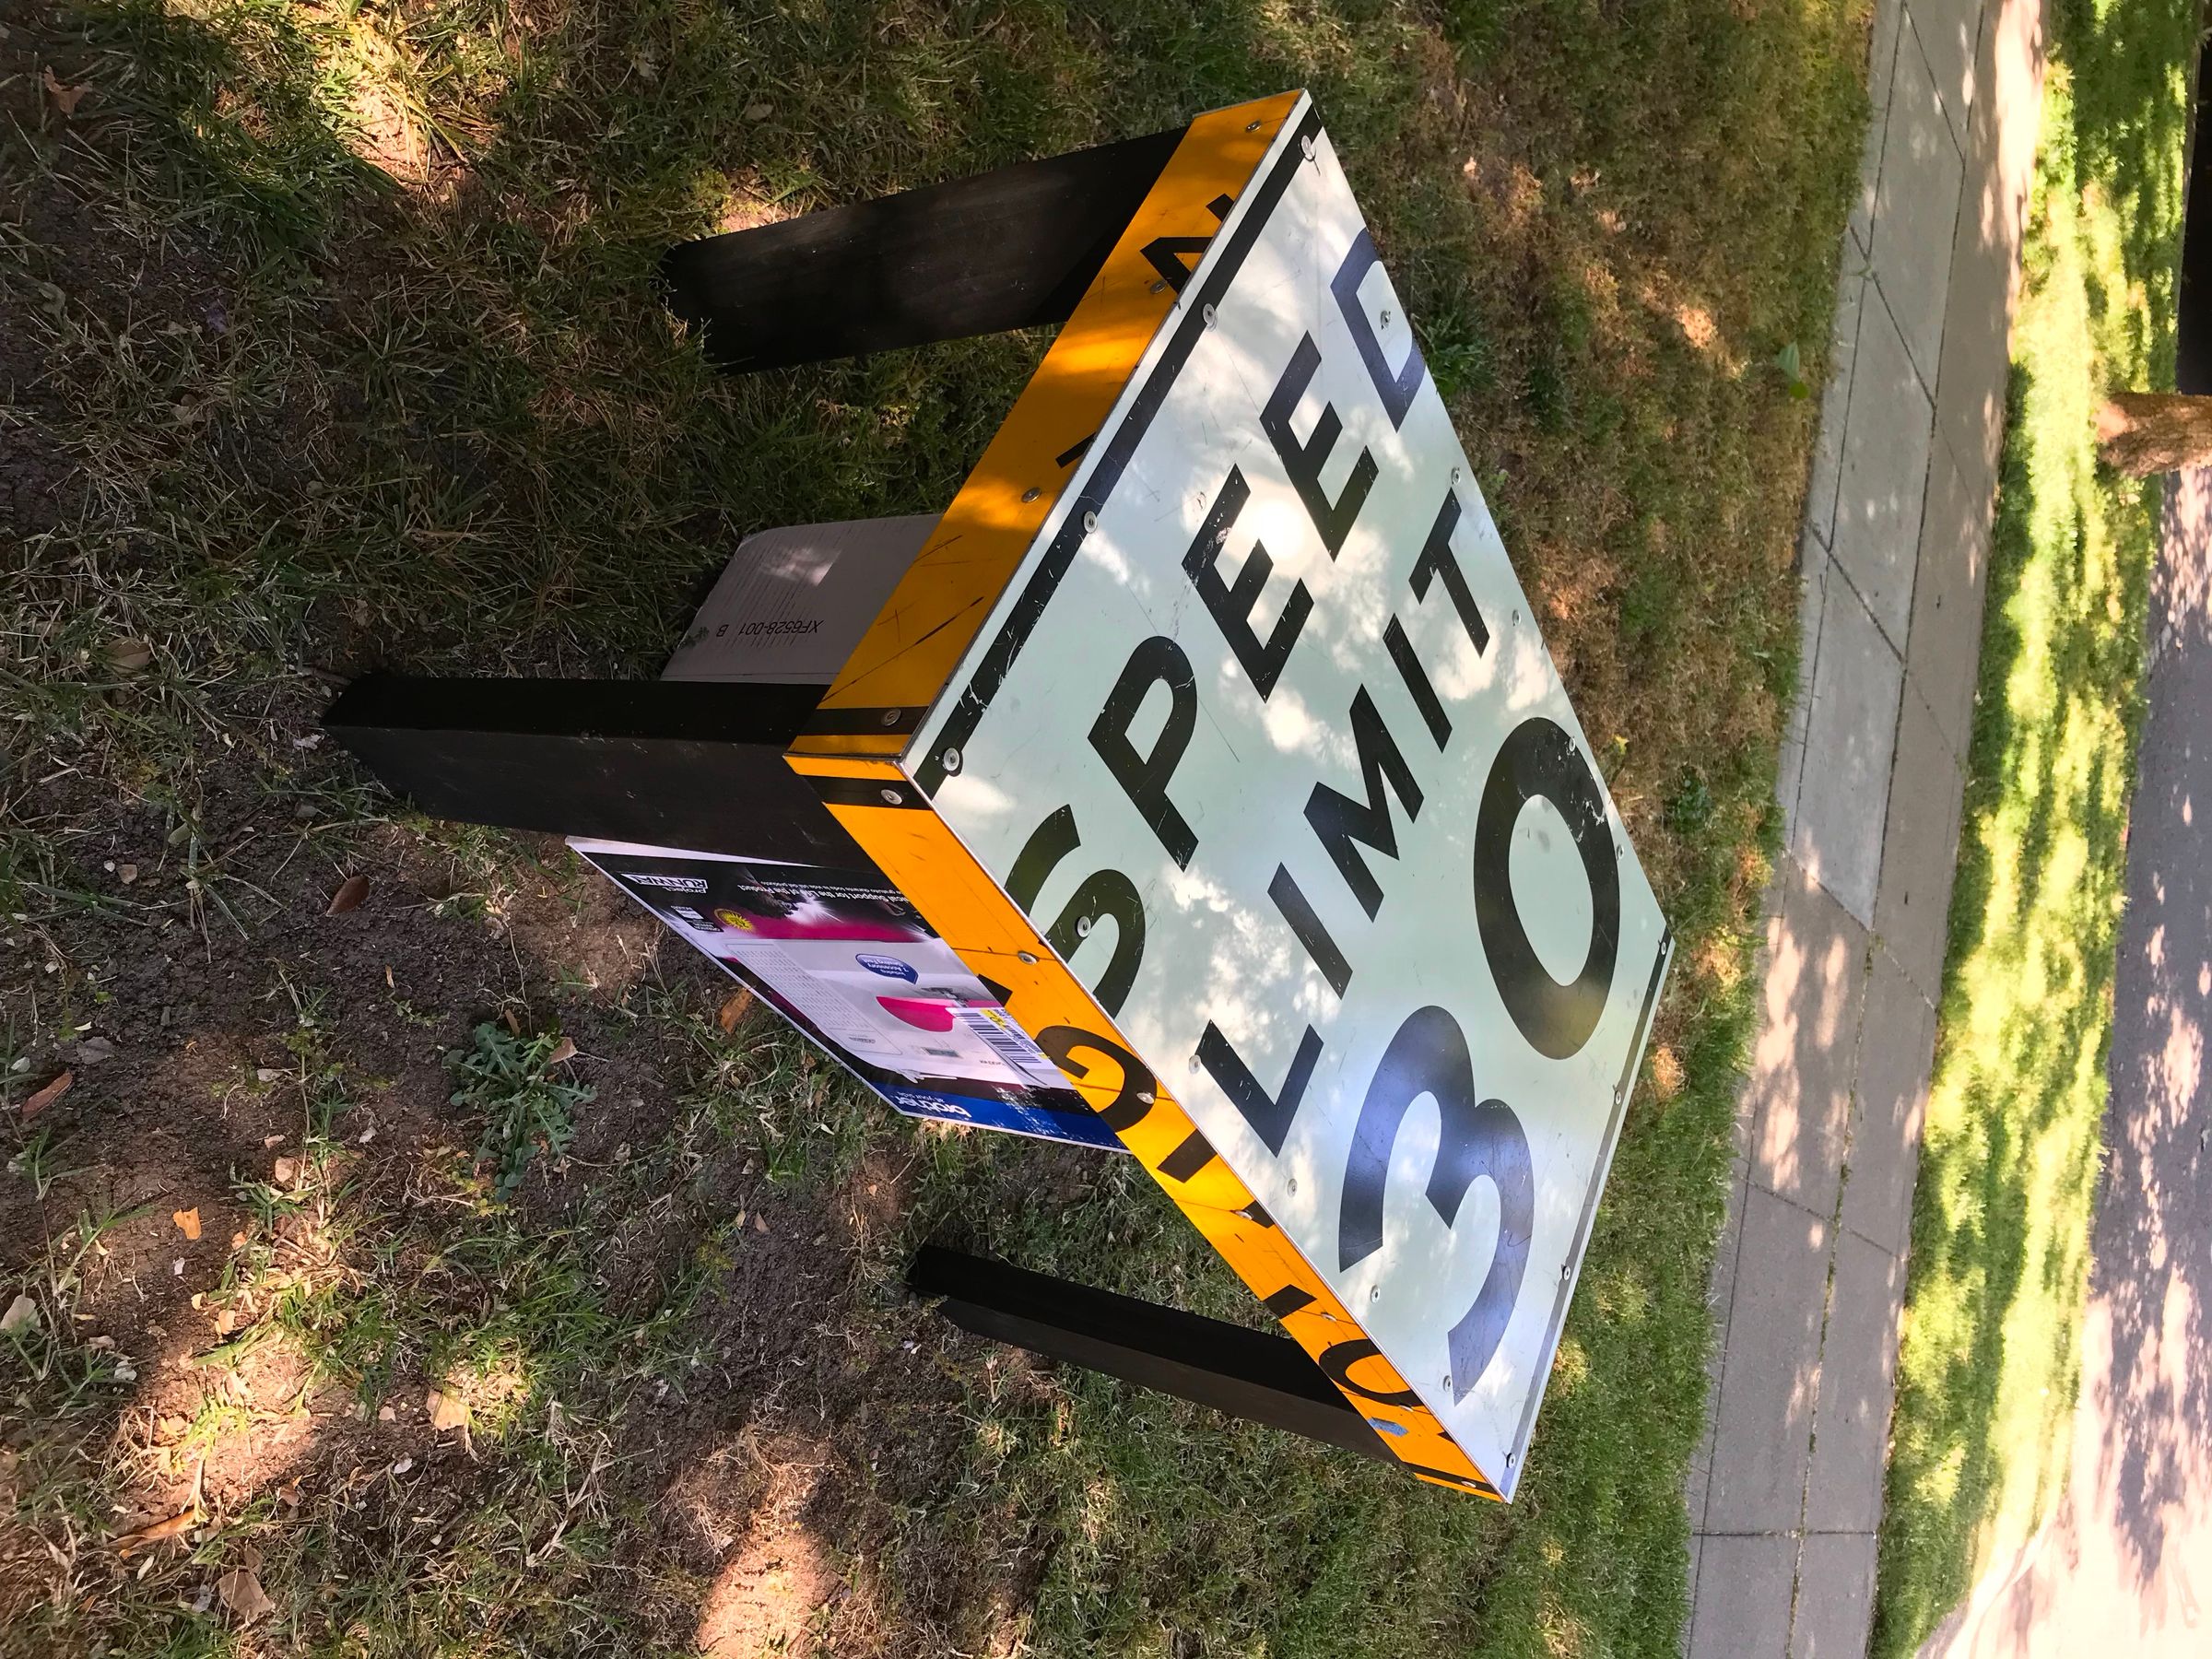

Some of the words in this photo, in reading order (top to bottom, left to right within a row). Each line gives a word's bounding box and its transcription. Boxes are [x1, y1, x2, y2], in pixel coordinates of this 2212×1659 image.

[716, 624, 730, 637] B
[1004, 227, 1428, 1019] SPEED
[1194, 487, 1490, 1159] LIMIT
[662, 886, 707, 894] project
[737, 885, 775, 893] Product
[849, 892, 888, 902] Support
[1337, 716, 1621, 1406] 30
[895, 1096, 971, 1118] brother
